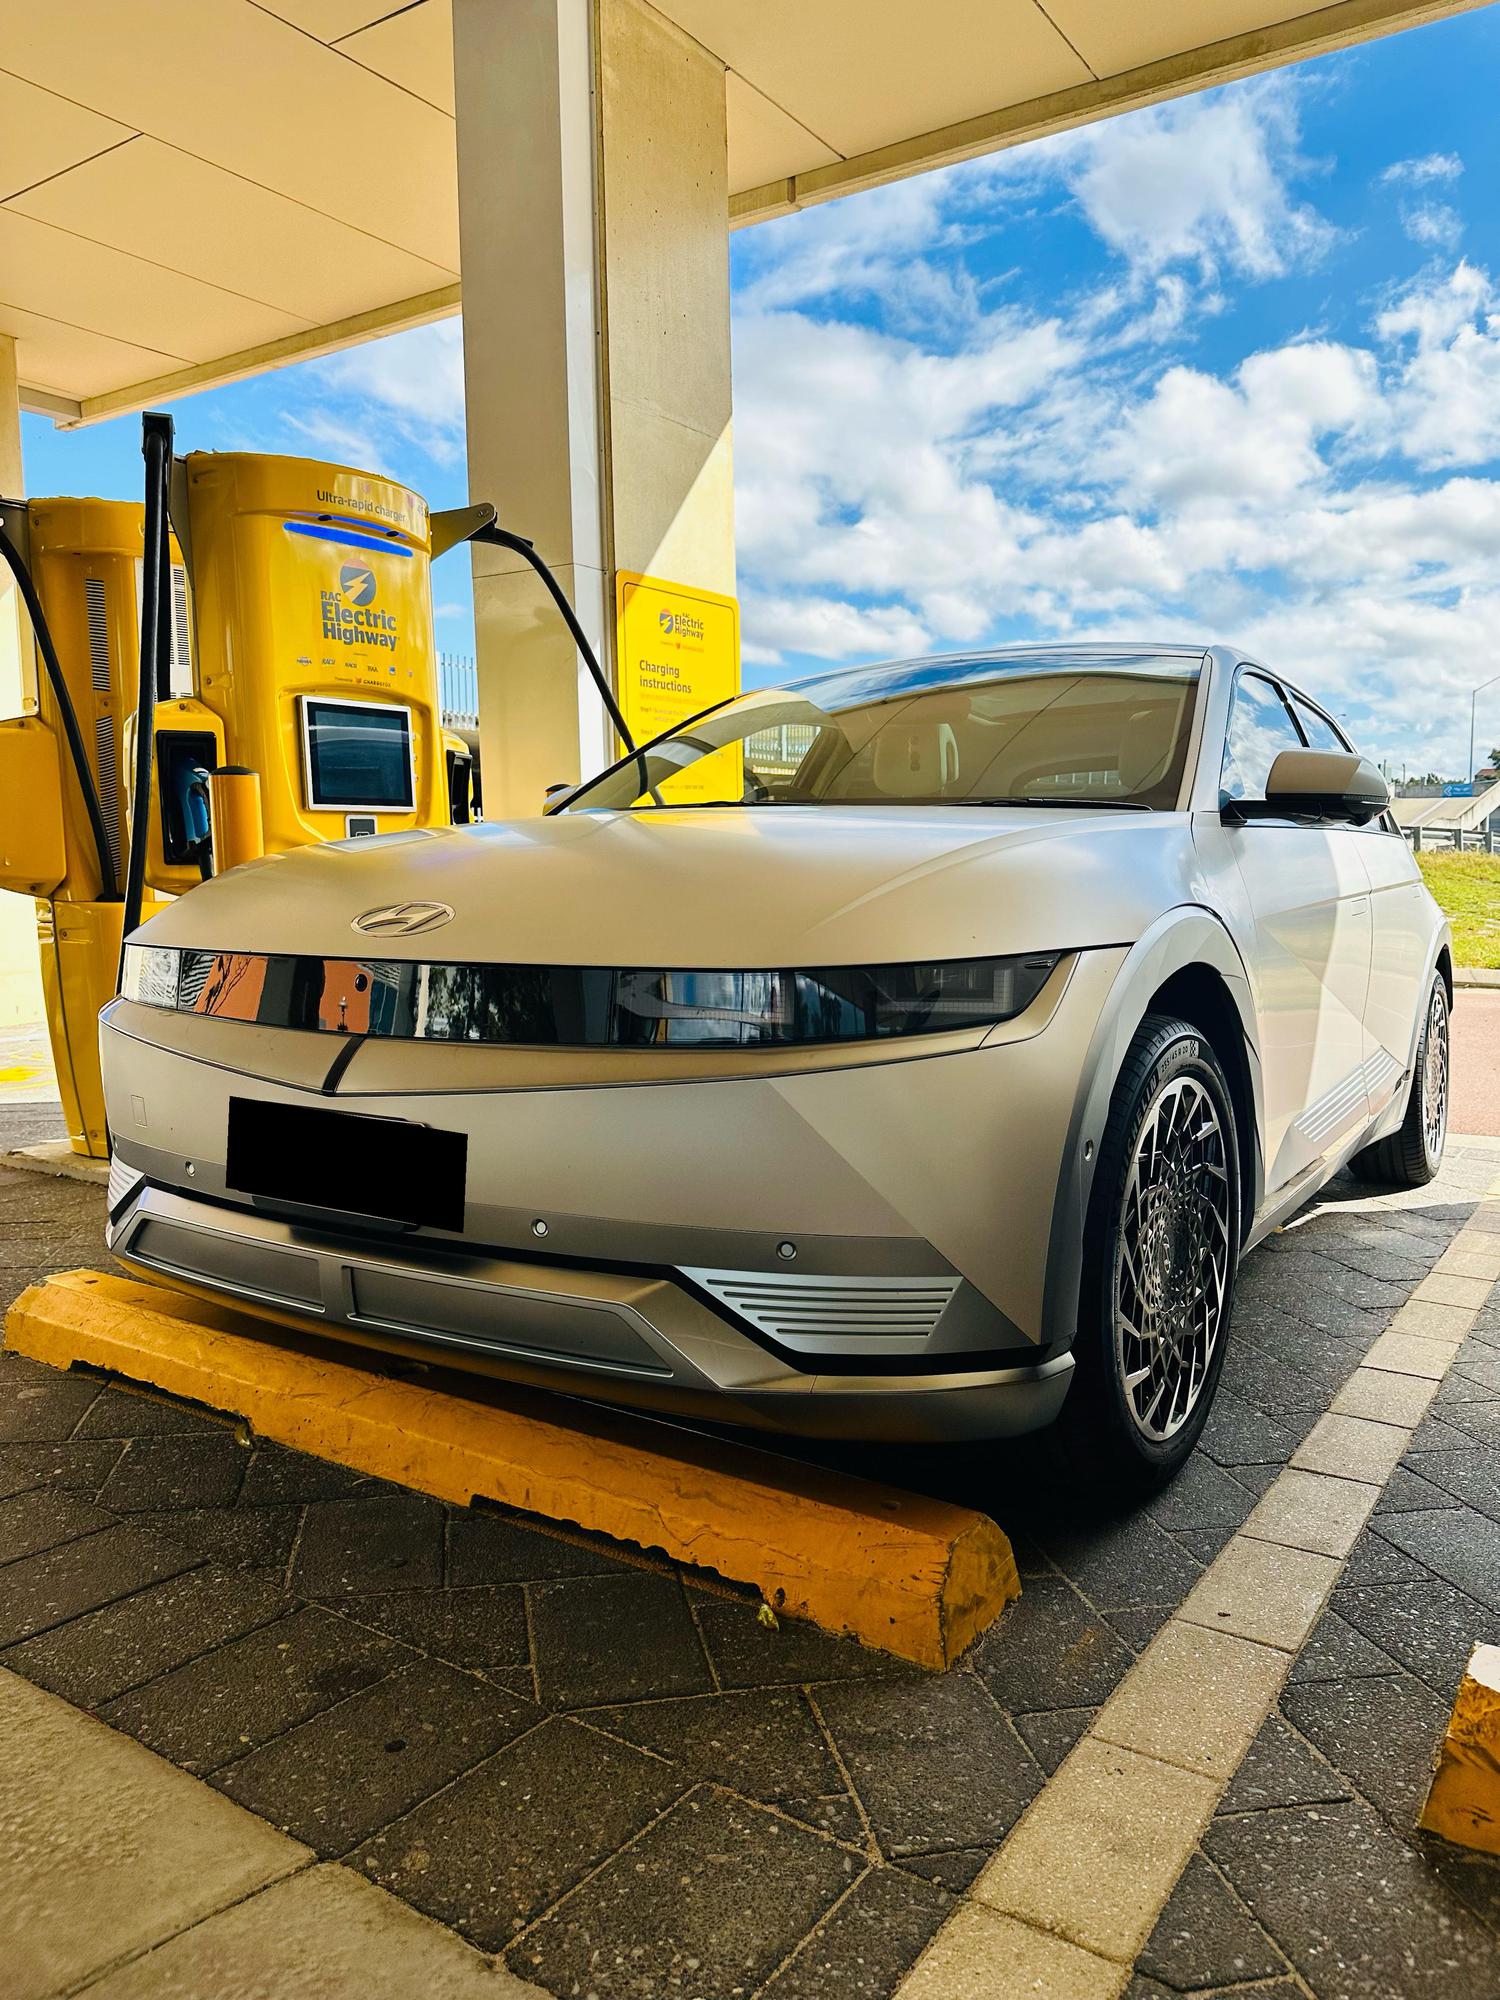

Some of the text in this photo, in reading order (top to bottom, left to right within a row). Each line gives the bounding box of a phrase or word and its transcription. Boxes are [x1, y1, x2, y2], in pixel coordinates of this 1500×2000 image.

[317, 489, 373, 512] Ultra-rapid
[374, 504, 406, 522] charger
[320, 590, 342, 602] RAC
[321, 600, 397, 632] Electric
[674, 614, 704, 630] Electric
[322, 621, 398, 652] Highway
[674, 624, 704, 641] Highway
[639, 659, 680, 679] Charging
[639, 675, 692, 694] instructions
